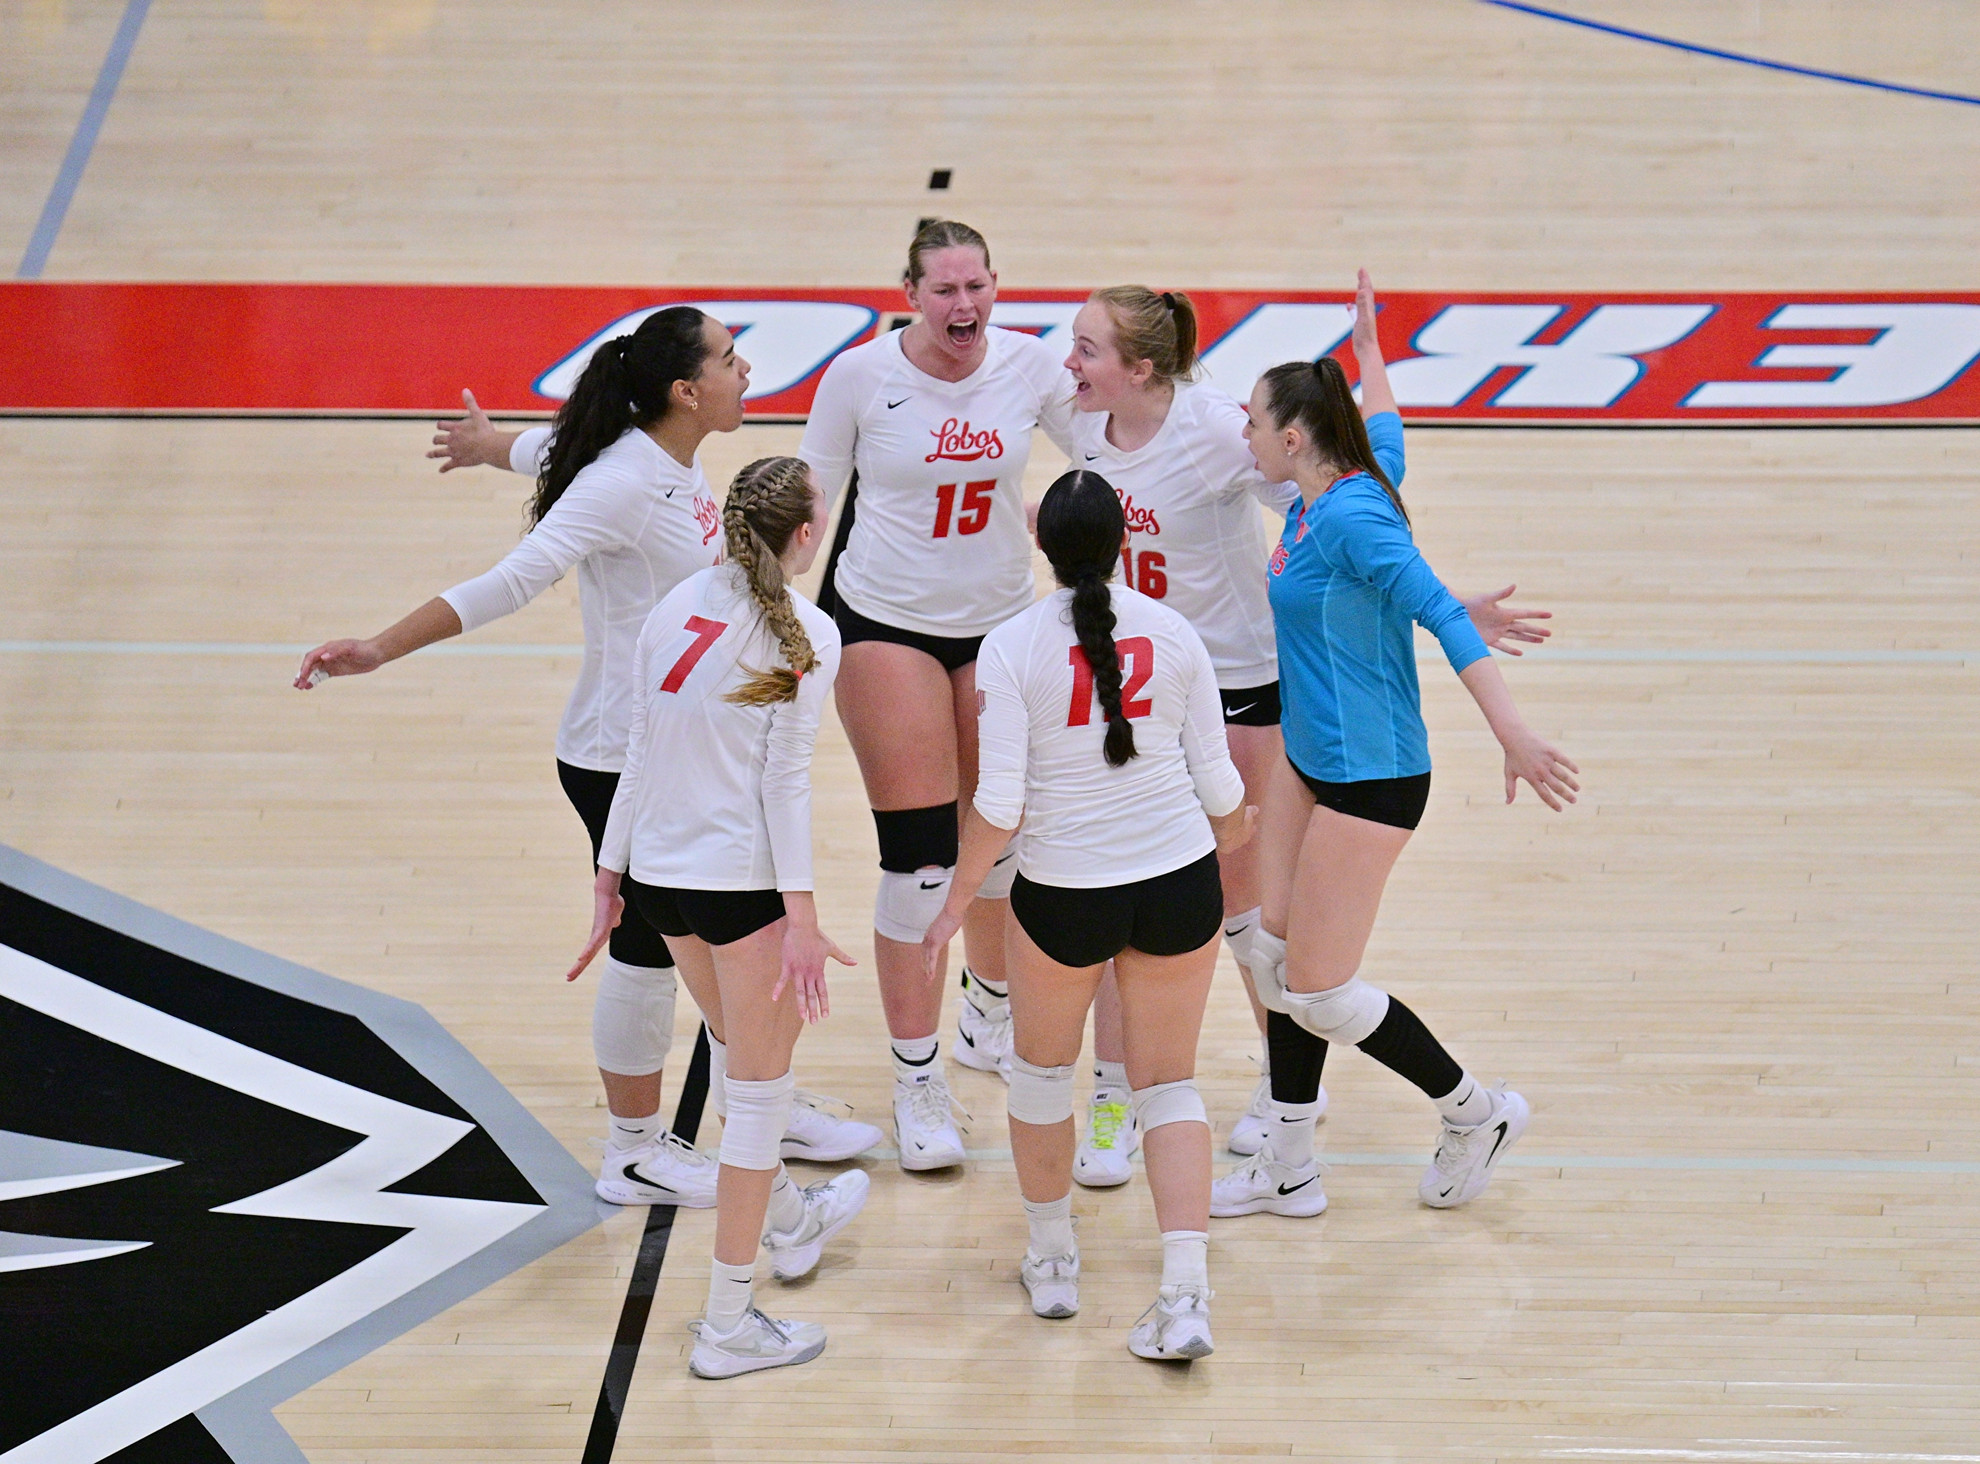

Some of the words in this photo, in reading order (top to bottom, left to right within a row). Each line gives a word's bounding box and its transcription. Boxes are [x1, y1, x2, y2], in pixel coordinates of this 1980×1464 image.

[925, 417, 1004, 463] Lobos
[932, 479, 997, 539] 15
[1115, 488, 1160, 535] bos
[1121, 547, 1167, 600] 16
[660, 615, 729, 694] 7
[1067, 636, 1154, 727] 12
